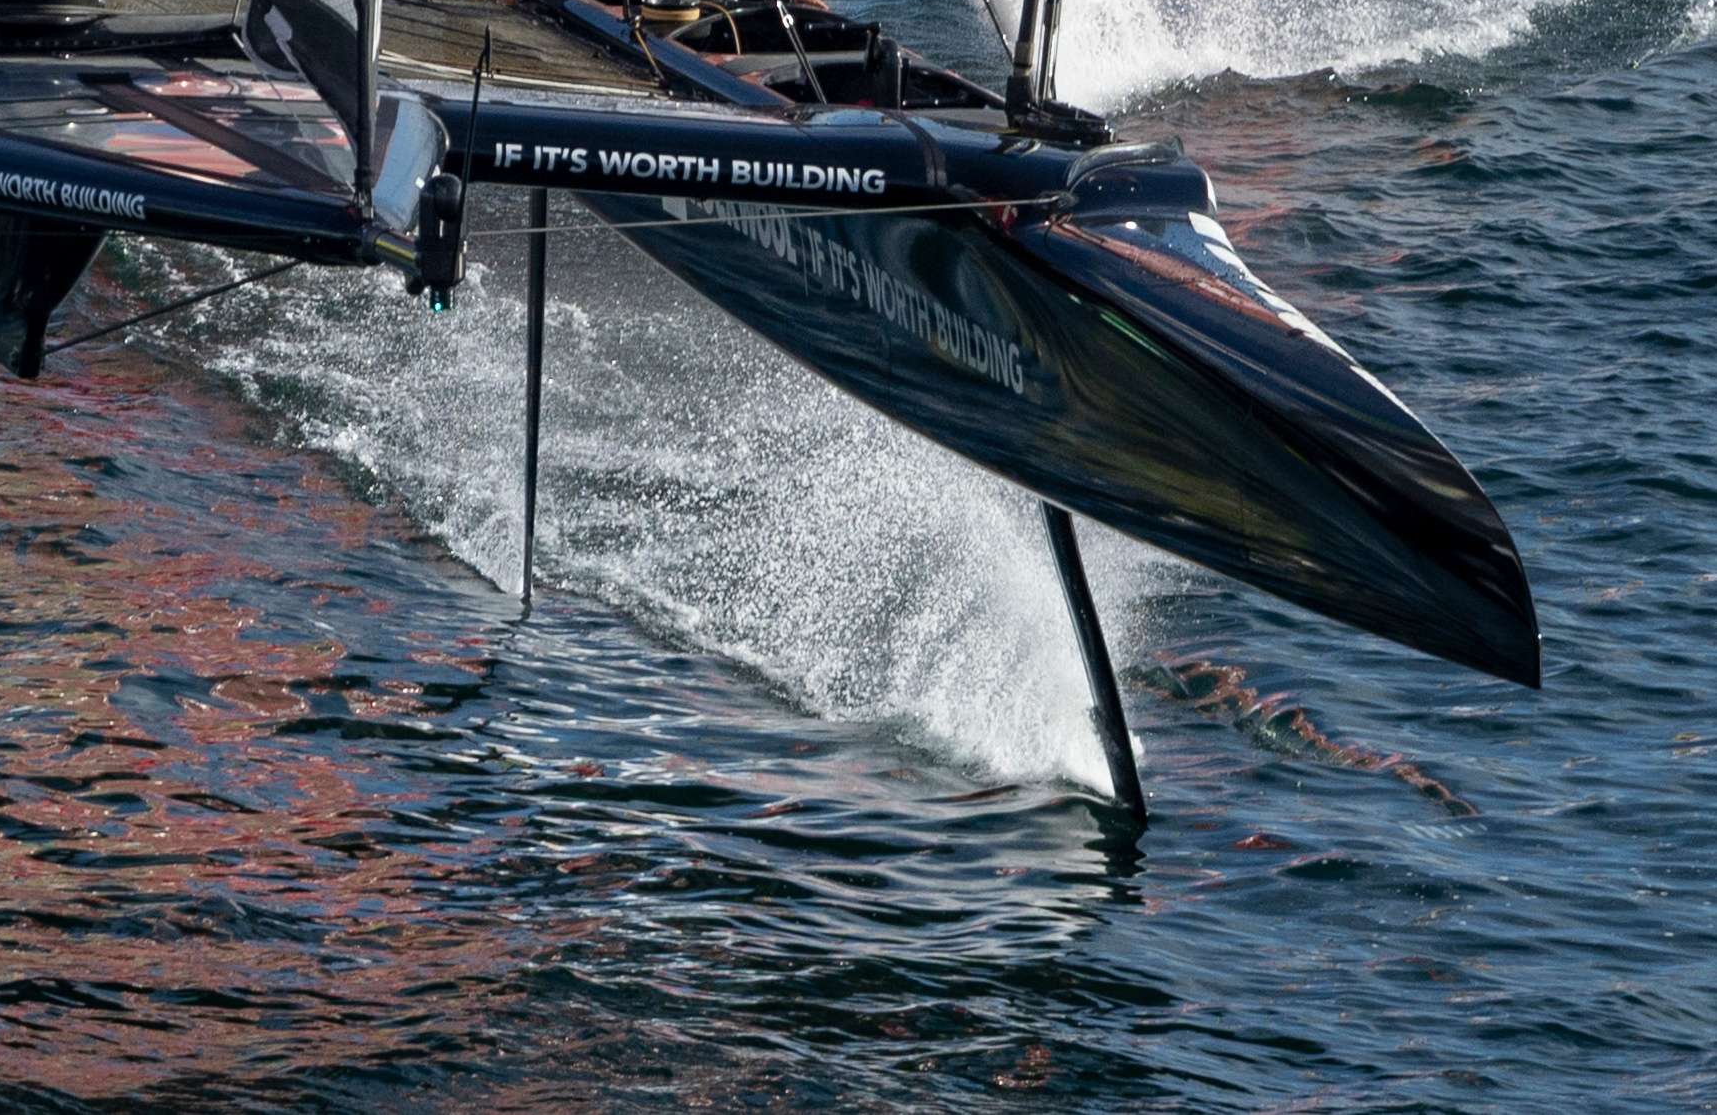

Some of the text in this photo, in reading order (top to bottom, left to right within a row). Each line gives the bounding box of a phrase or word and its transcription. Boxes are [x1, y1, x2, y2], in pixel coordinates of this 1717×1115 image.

[493, 142, 885, 195] IF IT'S WORTH BUILDING
[61, 183, 145, 220] BUILDING
[807, 227, 825, 277] IF
[828, 239, 861, 301] IT'S
[862, 260, 932, 344] WORTH
[934, 307, 1023, 396] BUILDING
